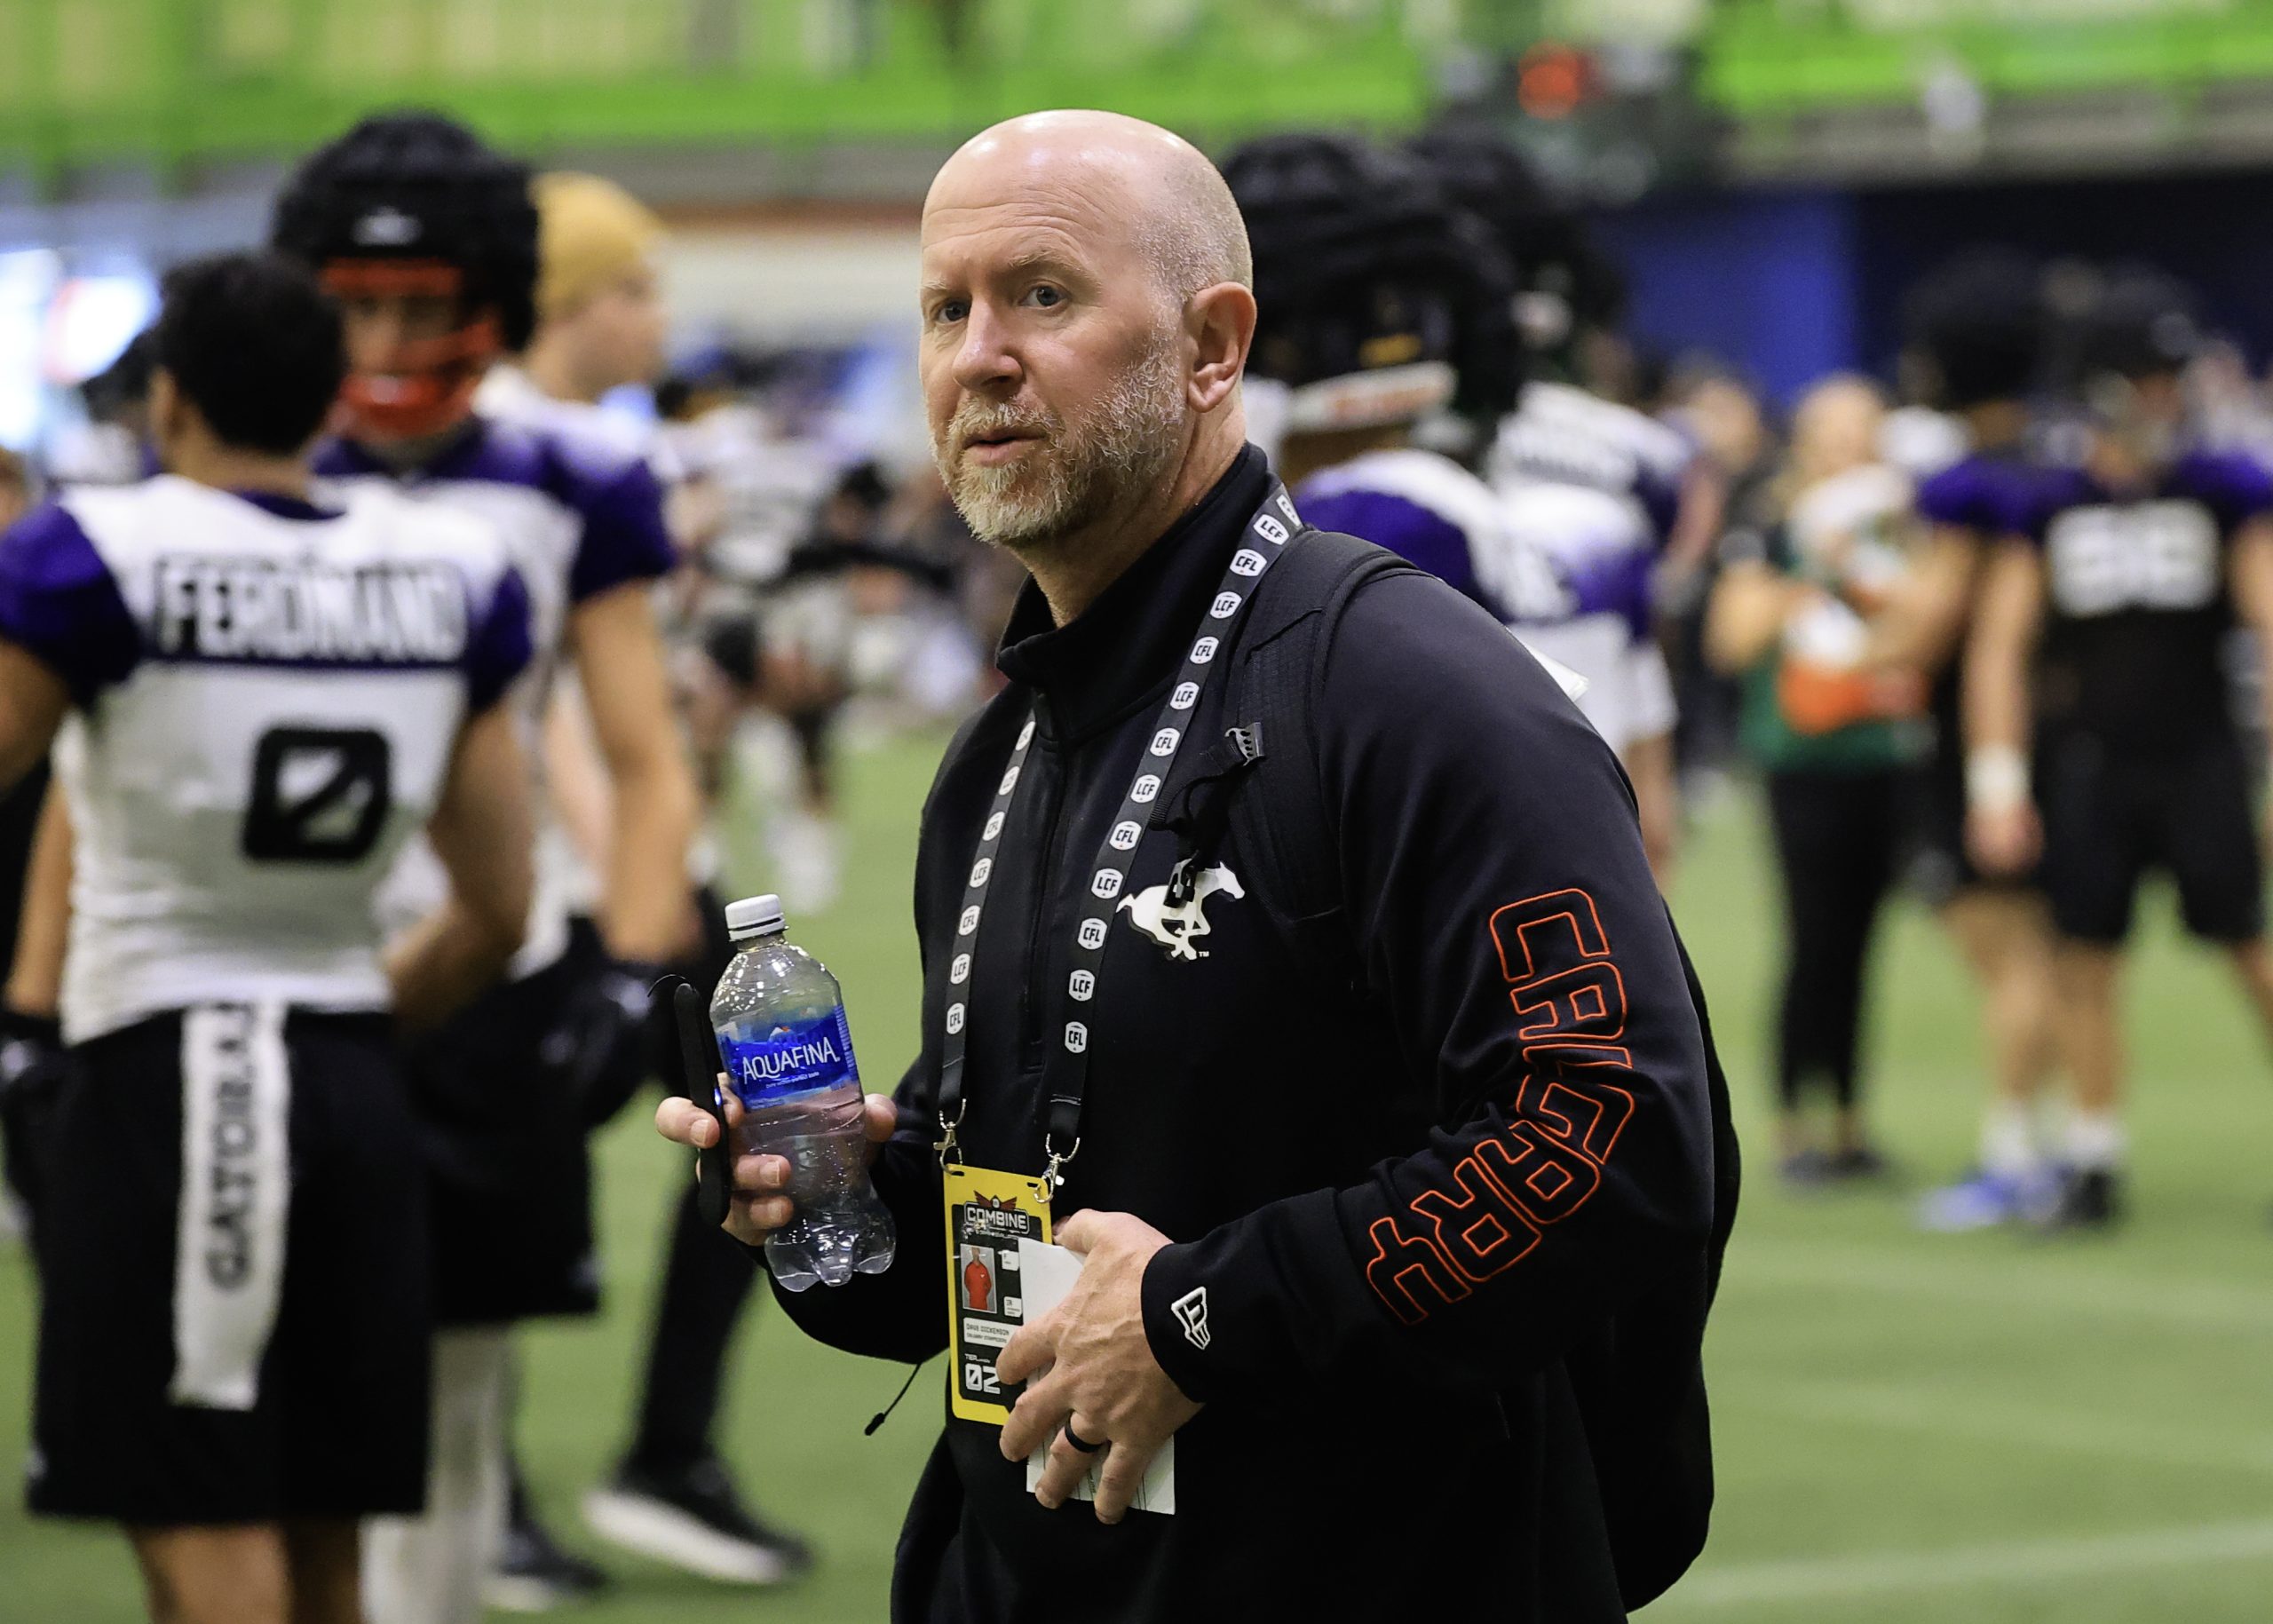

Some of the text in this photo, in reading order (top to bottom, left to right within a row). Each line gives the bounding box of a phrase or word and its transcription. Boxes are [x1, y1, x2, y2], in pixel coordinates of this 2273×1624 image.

[1260, 520, 1284, 538] LCF
[1235, 556, 1257, 572] CFL
[1215, 599, 1236, 612] LCF
[1195, 645, 1212, 657] CFL
[1175, 690, 1194, 702] LCF
[1155, 736, 1173, 749] CFL
[240, 723, 392, 865] 0
[1136, 783, 1155, 796] LCF
[1115, 829, 1134, 843] CFL
[1097, 877, 1118, 891] LCF
[1082, 927, 1100, 942] CFL
[954, 962, 967, 977] LCF
[1073, 978, 1091, 994] LCF
[950, 1011, 961, 1027] CFL
[1068, 1030, 1083, 1046] CFL
[742, 1037, 838, 1084] AQUAFINA
[1367, 888, 1635, 1325] CALGARY
[967, 1207, 1027, 1230] COMBINE
[965, 1363, 1001, 1395] 02
